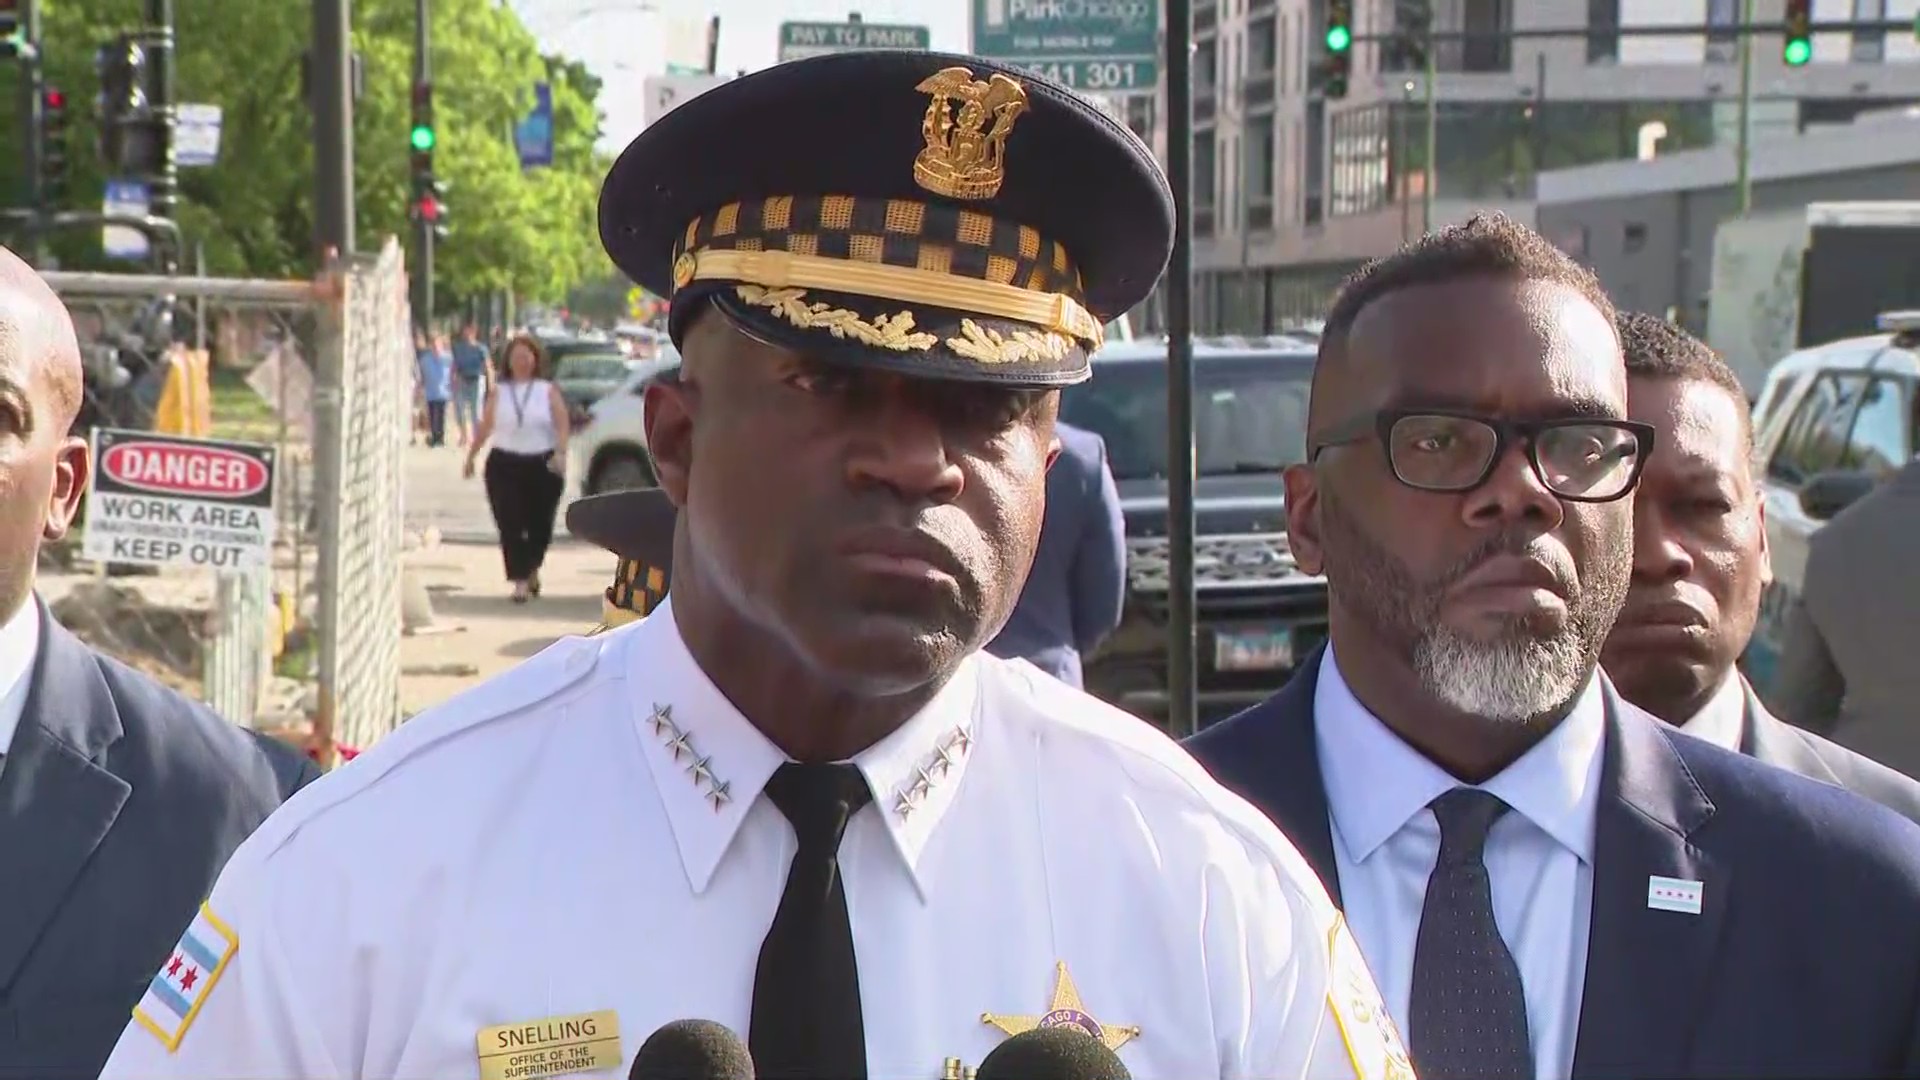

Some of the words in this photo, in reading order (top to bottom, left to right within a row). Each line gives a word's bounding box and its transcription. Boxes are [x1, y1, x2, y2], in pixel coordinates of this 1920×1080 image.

[790, 27, 827, 45] PAY
[834, 28, 860, 46] TO
[865, 29, 918, 47] PARK
[1086, 63, 1135, 87] 301
[121, 450, 248, 490] DANGER
[102, 498, 183, 523] WORK
[191, 506, 260, 529] AREA
[113, 538, 182, 560] KEEP
[190, 544, 243, 567] OUT
[498, 1019, 596, 1048] SNELLING
[505, 1056, 596, 1078] SUPERINTENDENT
[509, 1053, 546, 1066] OFFICE
[550, 1050, 564, 1060] OF
[569, 1047, 589, 1057] THE
